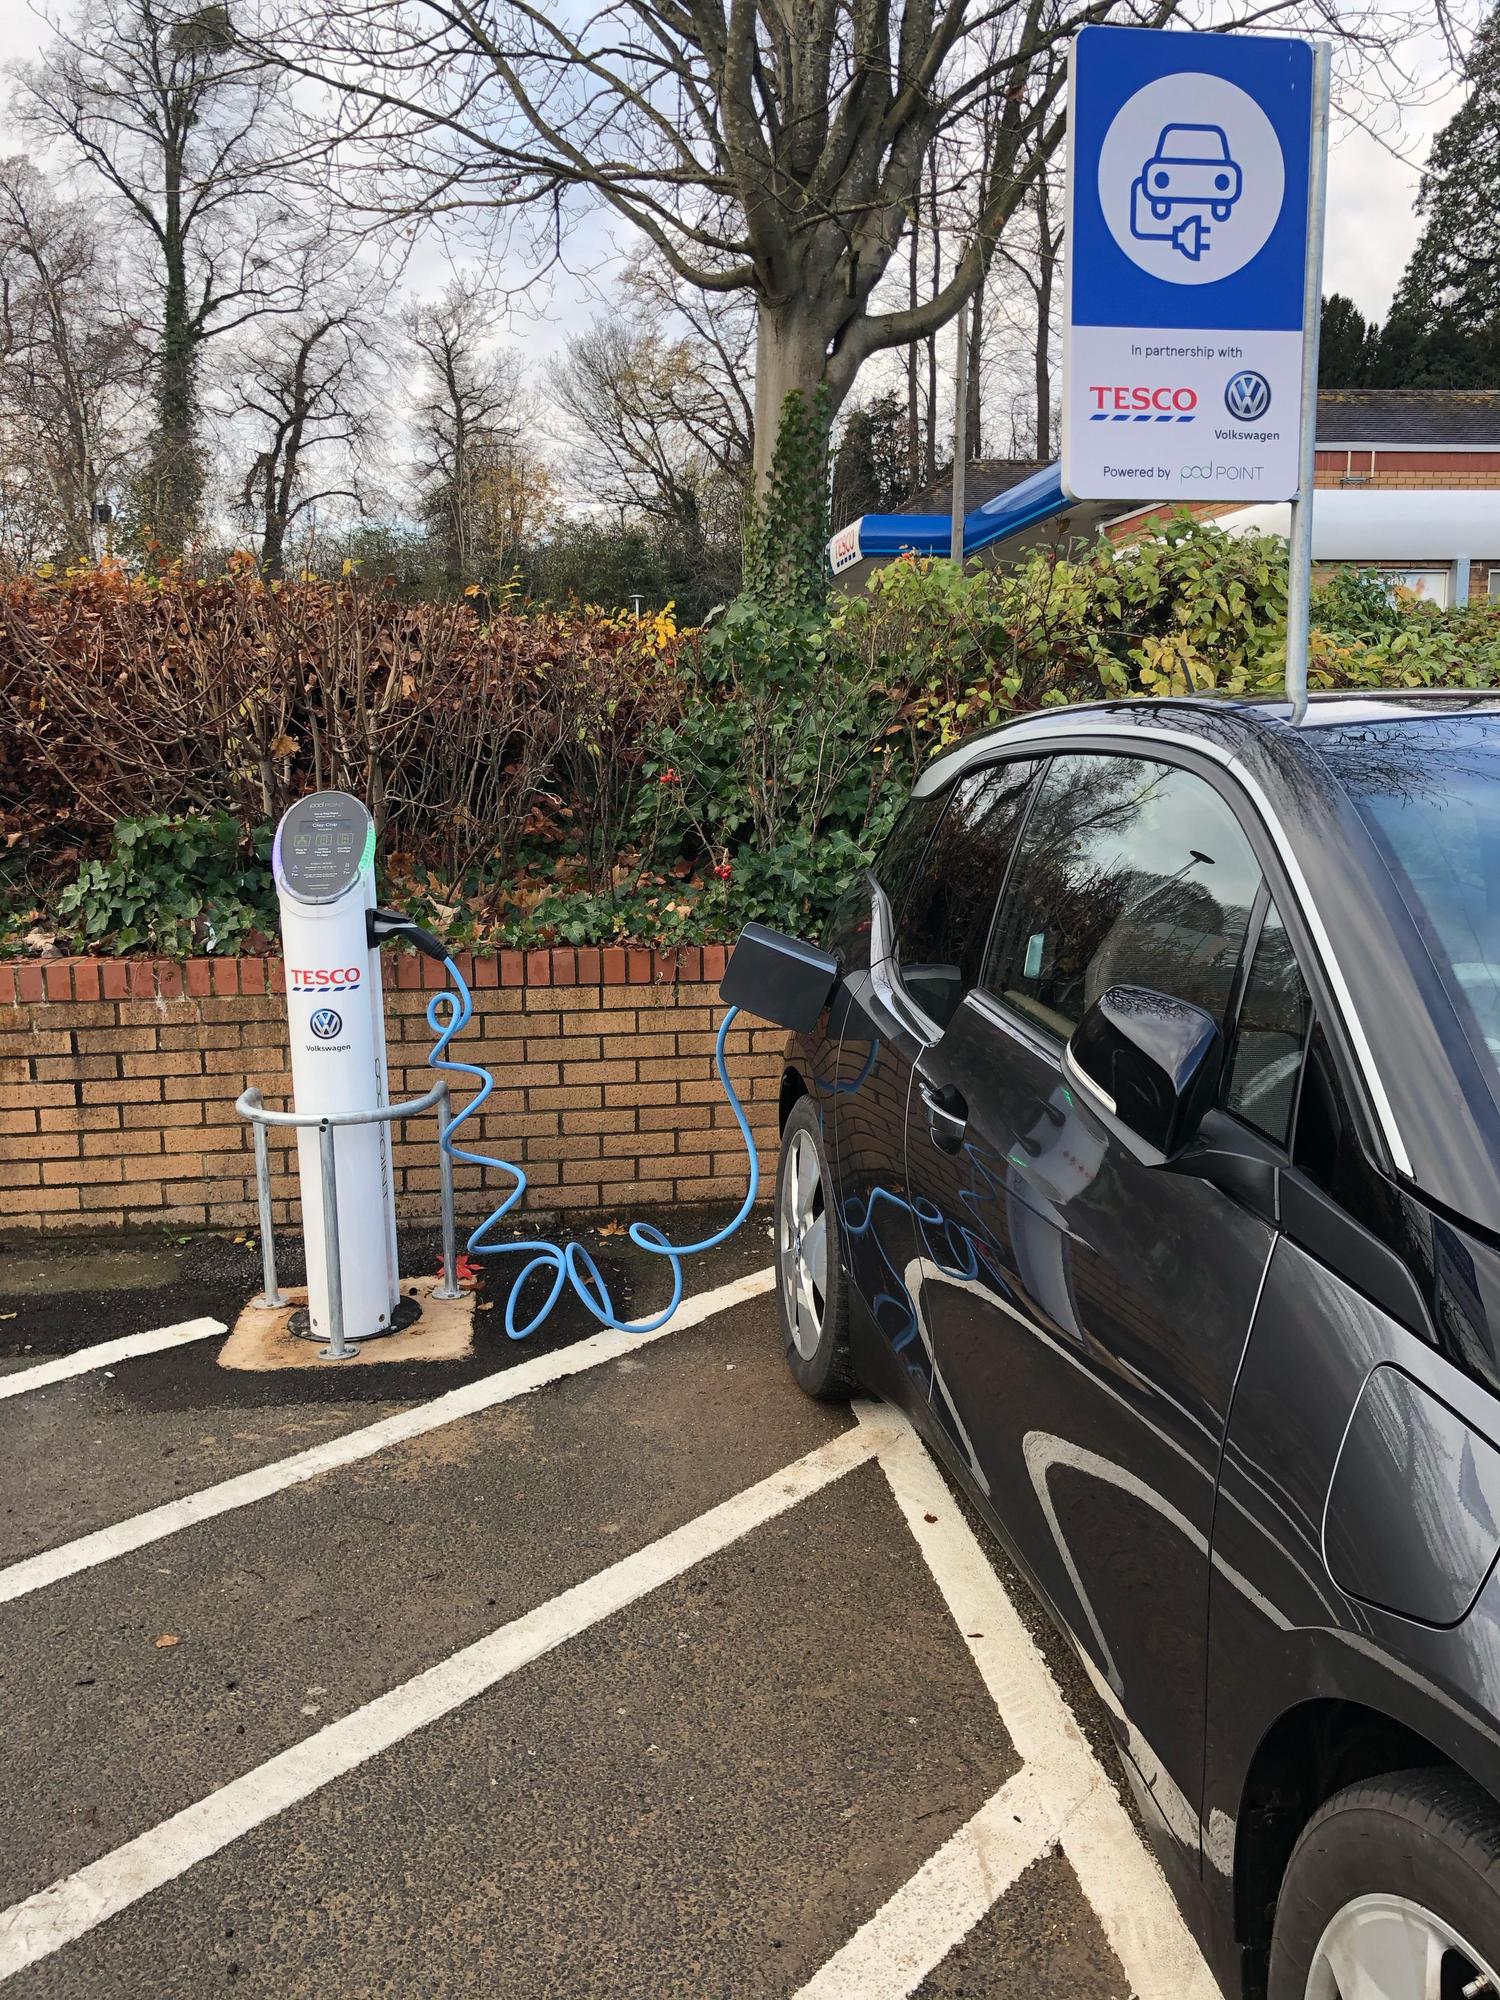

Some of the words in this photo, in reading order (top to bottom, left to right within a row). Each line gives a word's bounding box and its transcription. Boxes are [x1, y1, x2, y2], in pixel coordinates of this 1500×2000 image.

[1131, 344, 1142, 356] In
[1145, 345, 1215, 360] partnership
[1217, 346, 1243, 358] with
[1089, 386, 1198, 411] TESCO
[1214, 429, 1280, 442] Volkswagen
[1103, 466, 1154, 478] Powered
[1157, 466, 1171, 480] by
[1180, 460, 1213, 485] pod
[1216, 466, 1264, 481] POINT
[291, 967, 361, 985] TESCO
[305, 1044, 351, 1053] Volkswagen
